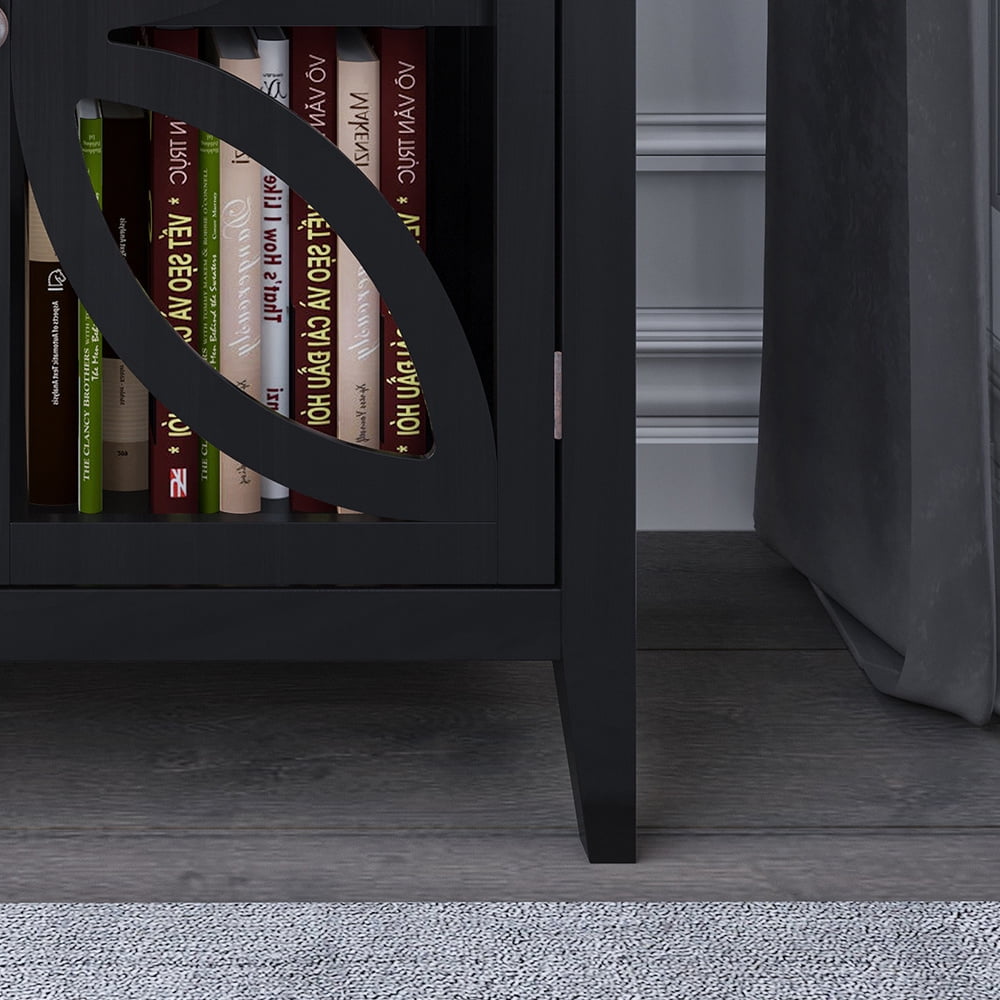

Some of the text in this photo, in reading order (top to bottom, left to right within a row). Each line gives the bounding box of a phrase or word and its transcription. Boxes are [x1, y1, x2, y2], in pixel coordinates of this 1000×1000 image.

[209, 254, 217, 292] Sweaters
[209, 295, 217, 308] the
[209, 311, 217, 342] Behind
[91, 324, 100, 381] The Men Beh
[83, 348, 91, 406] BROTHERS
[83, 410, 91, 457] CLANCY
[83, 466, 91, 481] THE
[200, 458, 208, 481] THE
